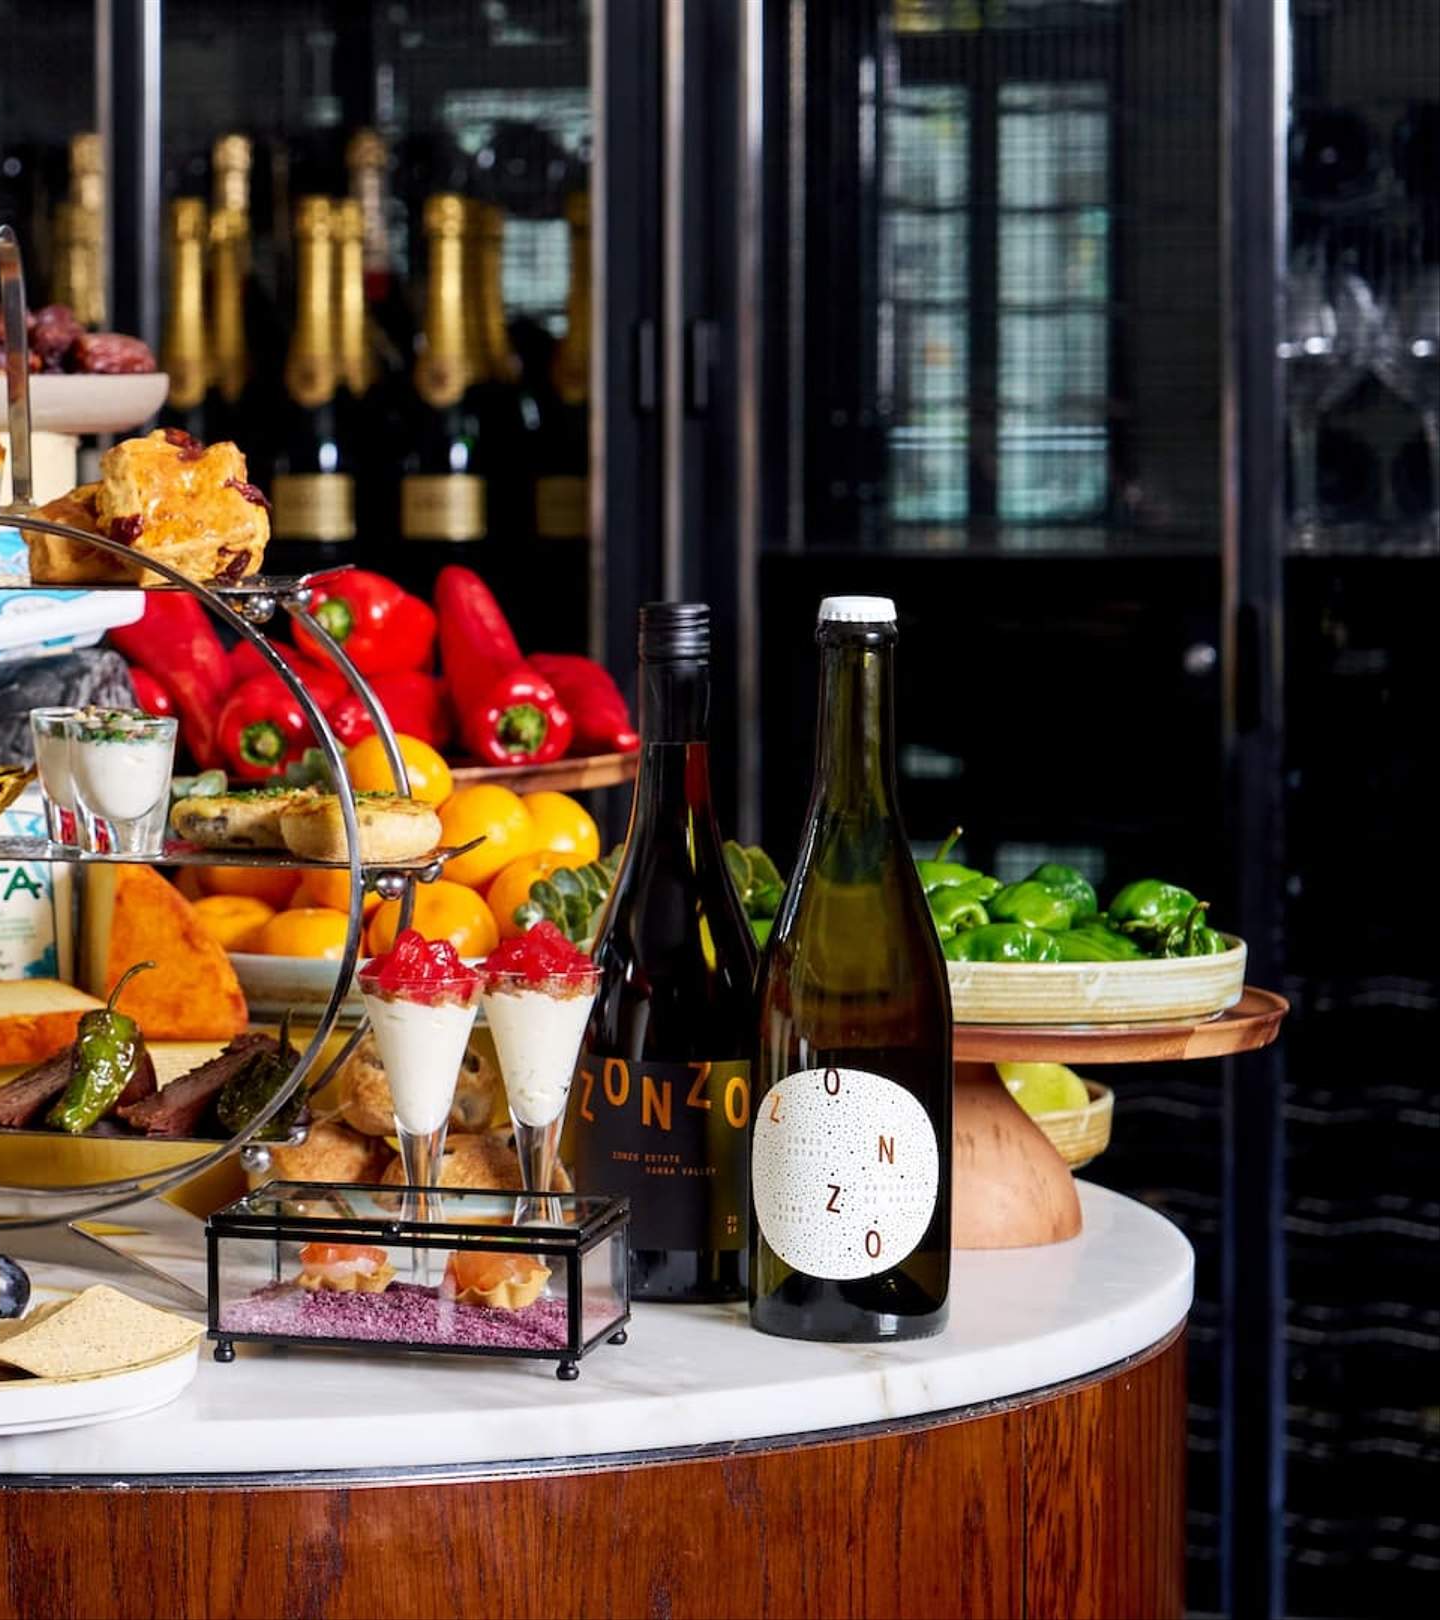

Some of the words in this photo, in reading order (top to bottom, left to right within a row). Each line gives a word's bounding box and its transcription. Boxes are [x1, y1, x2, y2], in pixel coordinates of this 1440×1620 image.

[580, 1057, 750, 1131] ZONZO
[645, 1153, 681, 1163] ESTATE
[681, 1167, 717, 1177] VALLEY
